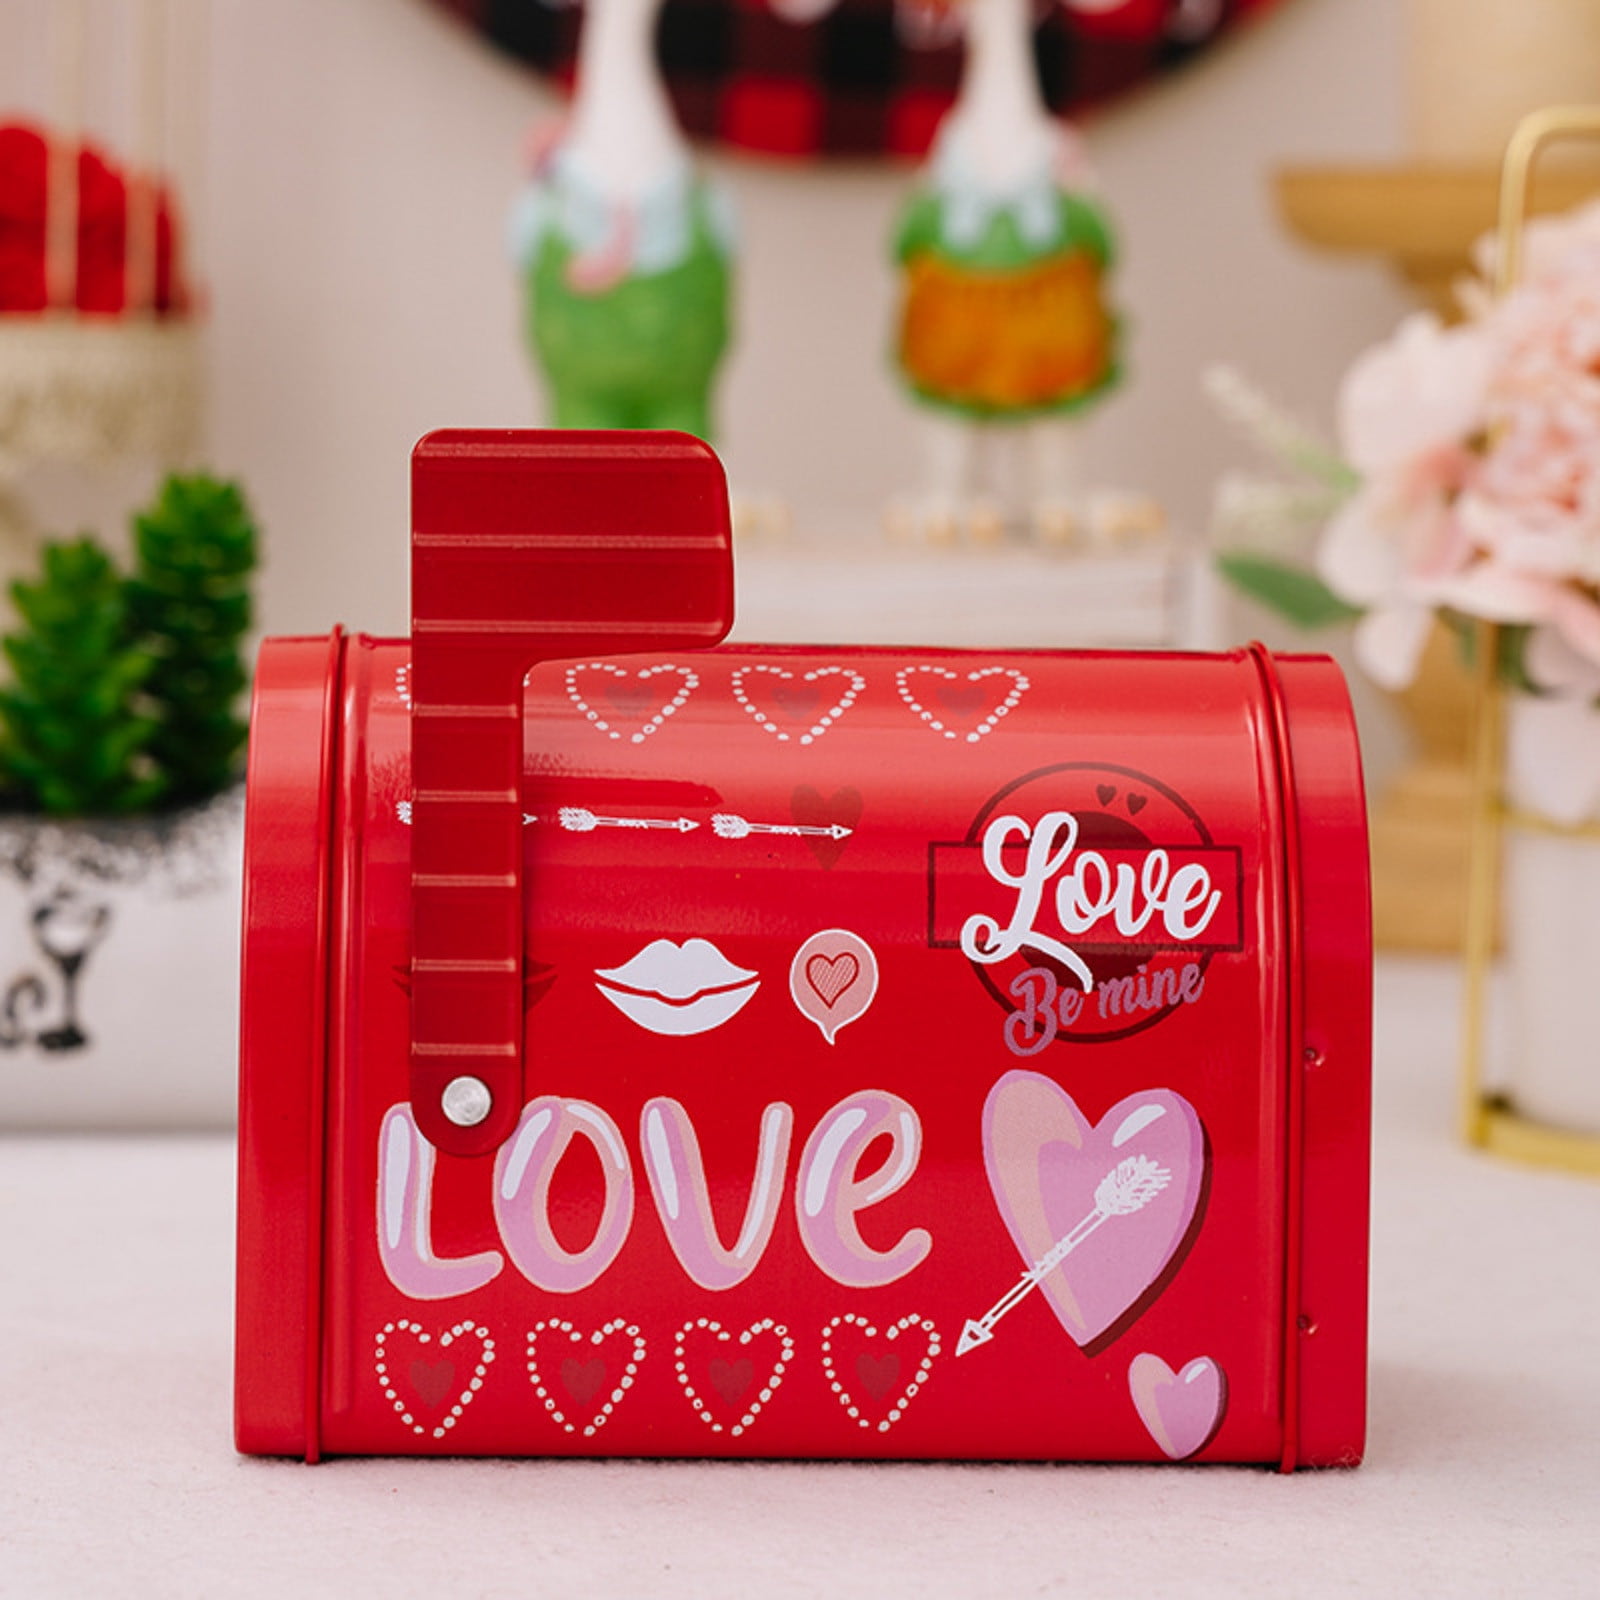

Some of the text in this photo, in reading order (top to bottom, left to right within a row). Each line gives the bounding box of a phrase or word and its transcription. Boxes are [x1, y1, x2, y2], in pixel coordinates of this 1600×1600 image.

[960, 811, 1222, 993] Love
[1004, 963, 1204, 1056] Be mine
